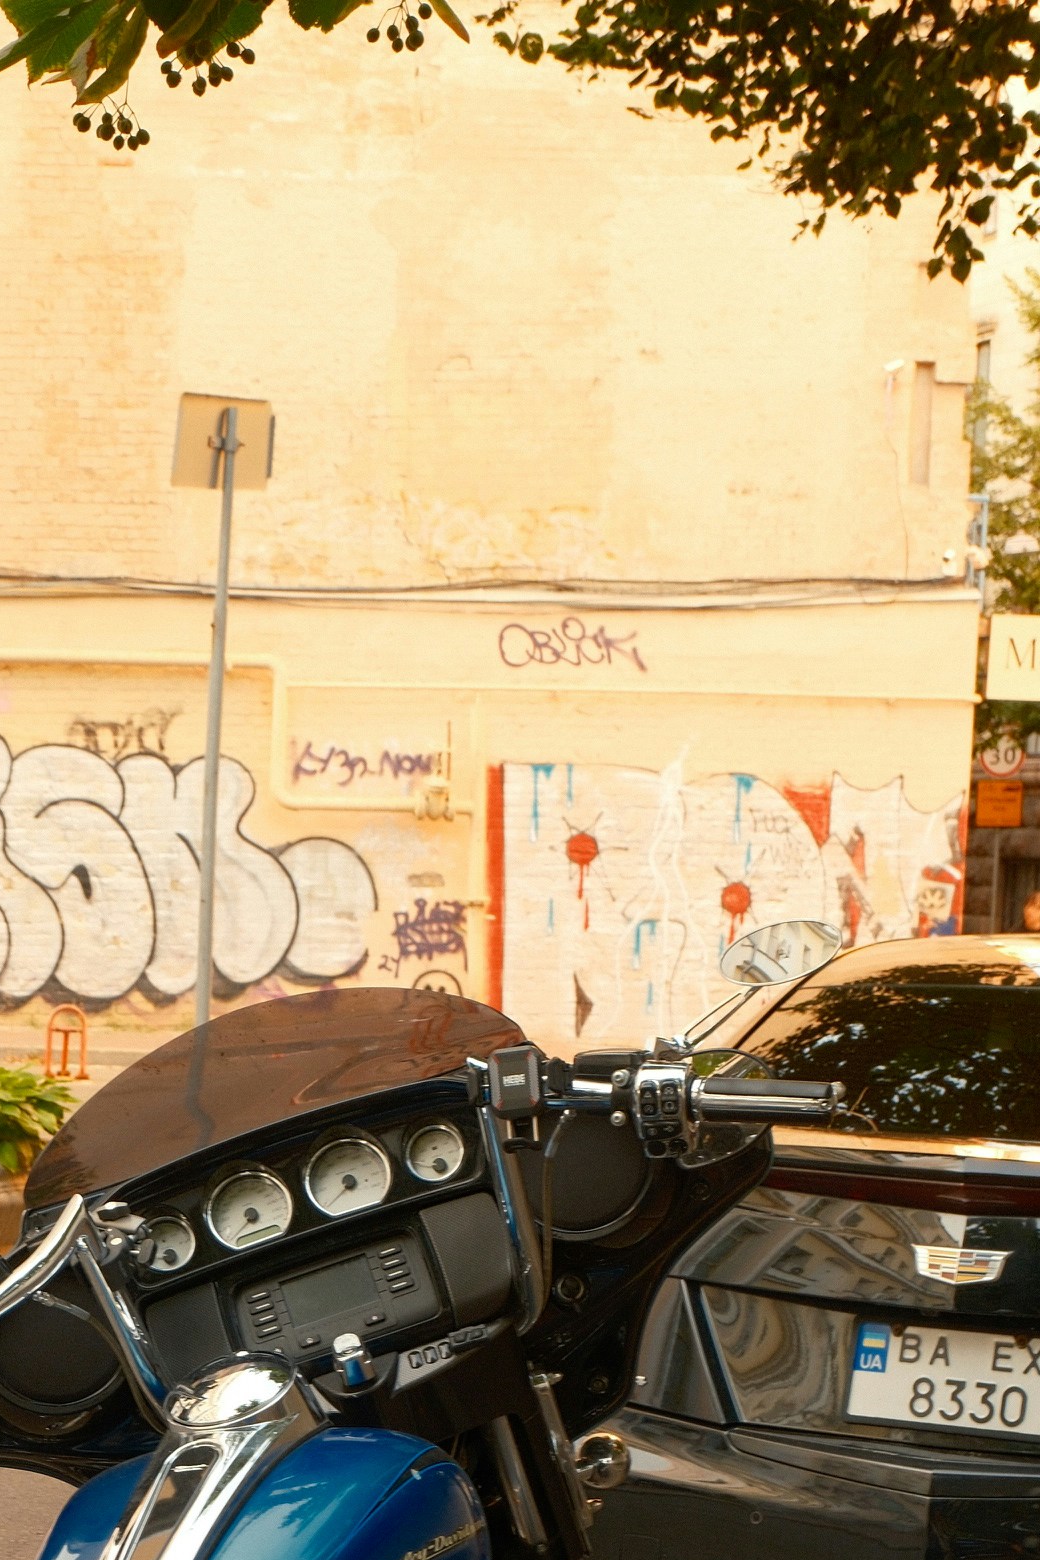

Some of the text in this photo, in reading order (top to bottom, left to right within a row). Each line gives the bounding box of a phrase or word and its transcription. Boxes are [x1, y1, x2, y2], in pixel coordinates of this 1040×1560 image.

[989, 747, 1016, 766] 30
[860, 1353, 882, 1370] UA
[898, 1332, 1040, 1375] BA EX
[910, 1376, 1028, 1428] 8330
